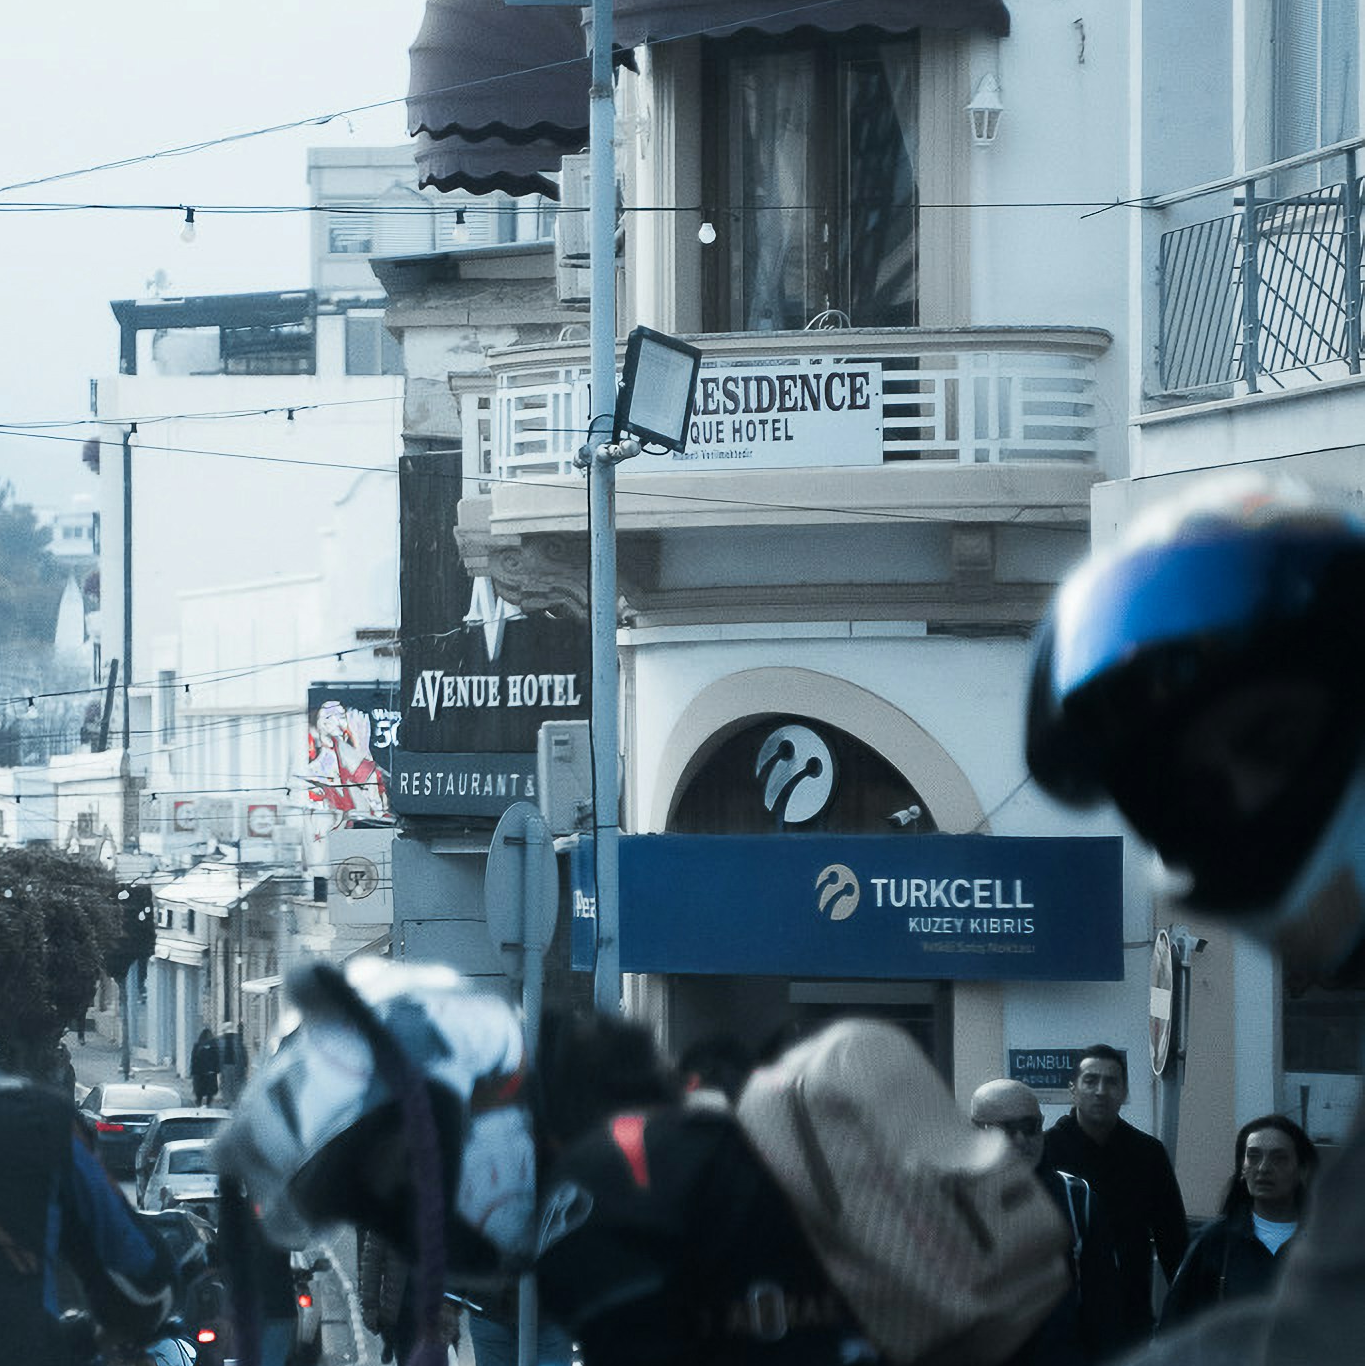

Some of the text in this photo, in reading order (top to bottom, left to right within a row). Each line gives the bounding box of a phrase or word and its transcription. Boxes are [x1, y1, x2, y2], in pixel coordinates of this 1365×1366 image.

[732, 417, 795, 443] HOTEL
[411, 670, 582, 721] AVENUE HOTEL
[400, 772, 520, 796] RESTAURANT
[870, 878, 1035, 908] TURKCELL
[908, 917, 1035, 934] KUZEY KIBRIS
